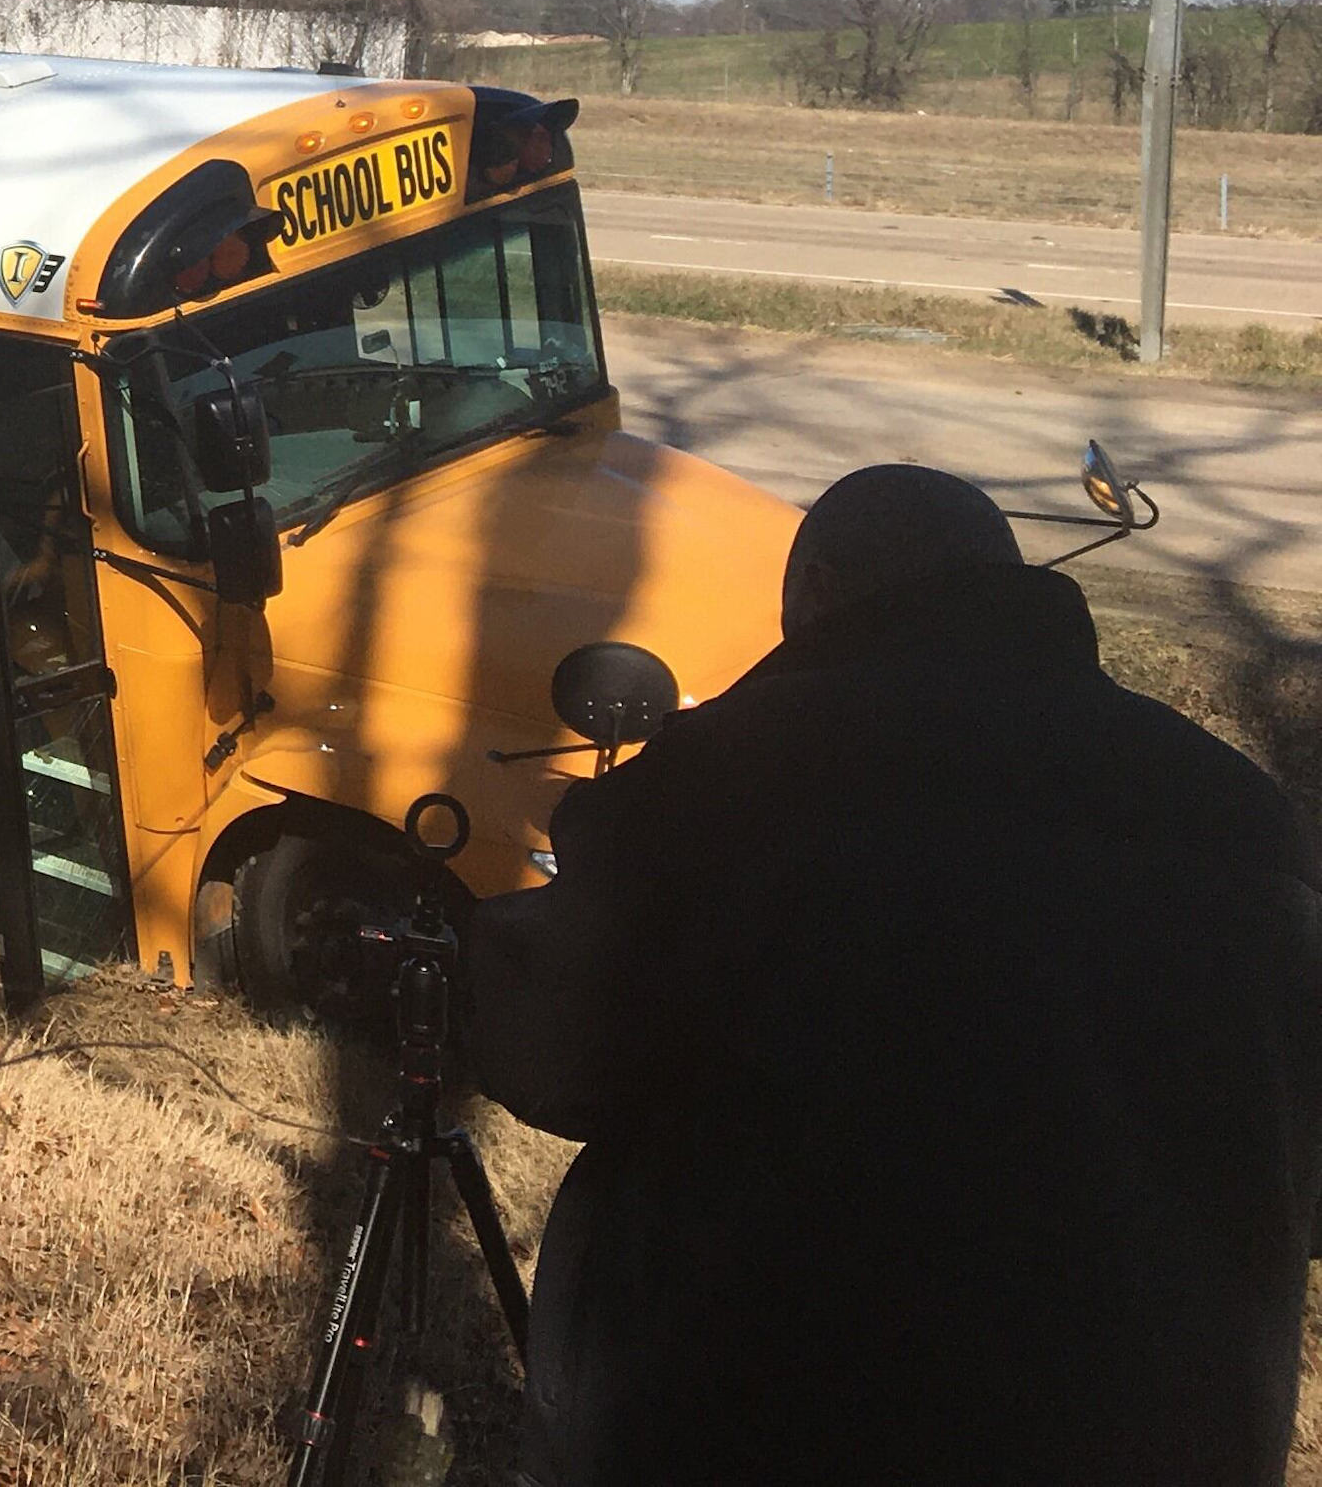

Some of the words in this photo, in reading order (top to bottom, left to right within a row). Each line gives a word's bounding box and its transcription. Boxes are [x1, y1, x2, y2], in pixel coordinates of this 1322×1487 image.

[277, 153, 394, 247] SCHOOL
[394, 131, 452, 208] BUS
[324, 1321, 340, 1344] Pro
